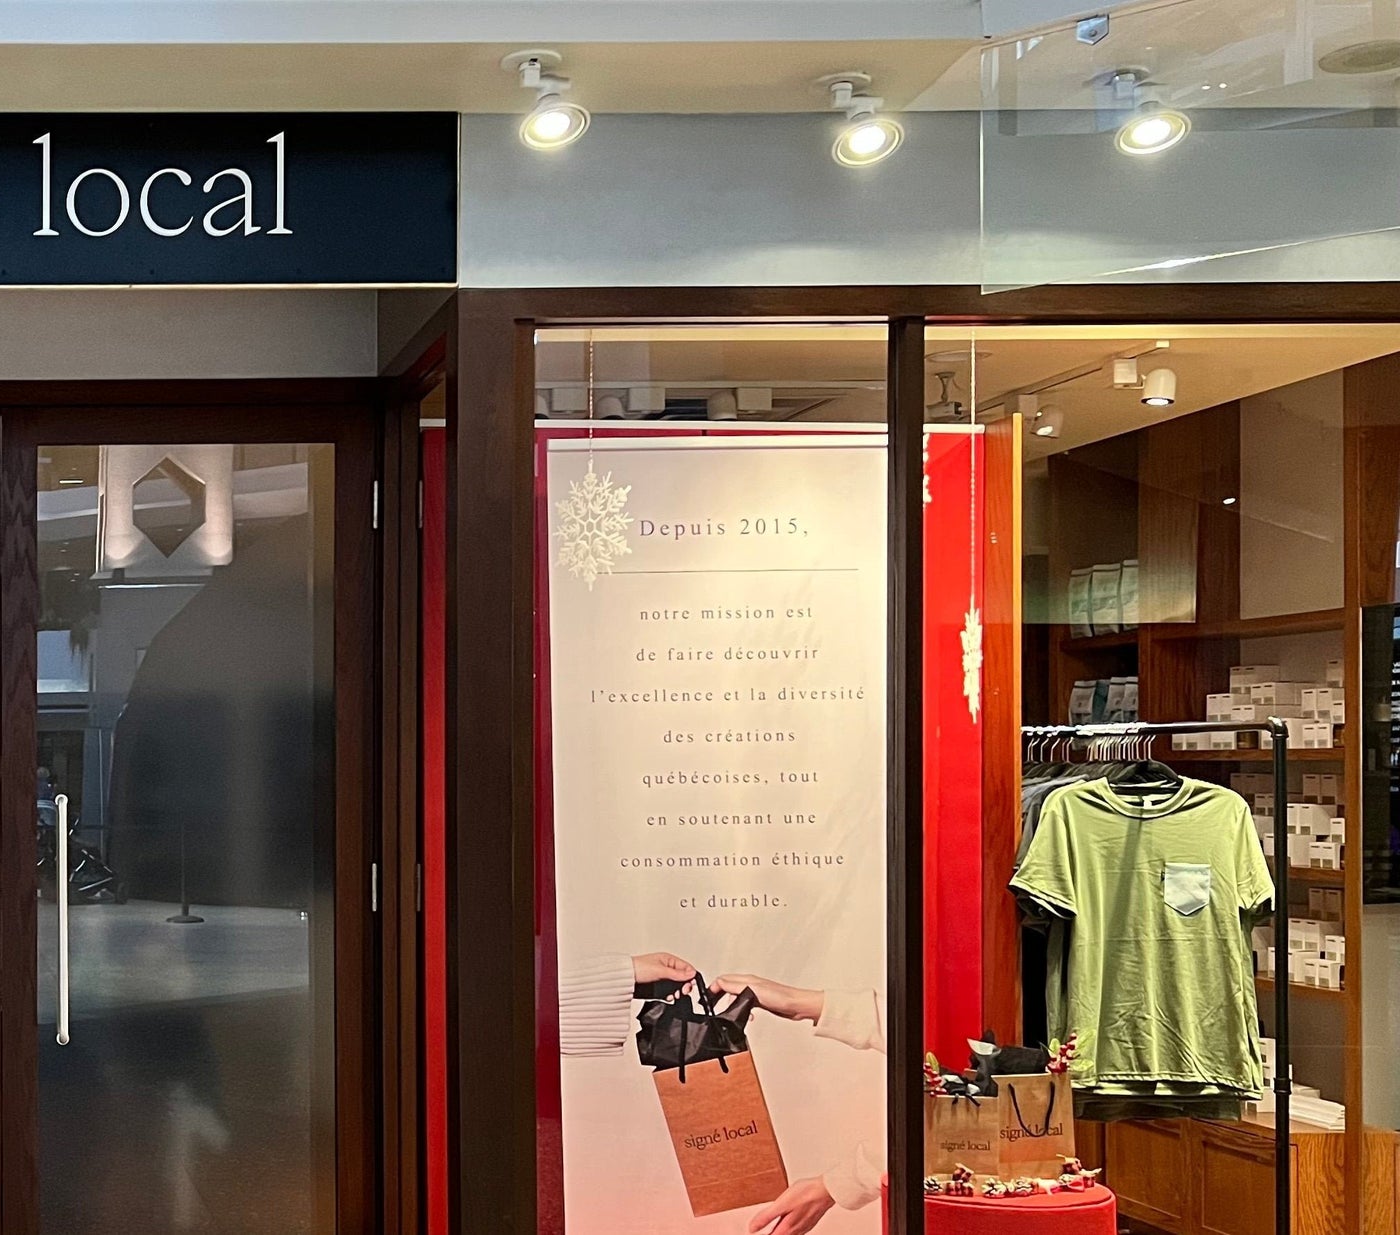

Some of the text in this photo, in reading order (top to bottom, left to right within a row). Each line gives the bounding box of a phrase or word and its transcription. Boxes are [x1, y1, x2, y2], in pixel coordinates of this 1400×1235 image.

[32, 131, 294, 237] local
[639, 518, 809, 540] Depuis 2015,
[639, 606, 812, 621] notre mission est
[636, 645, 819, 662] de faire découvrir
[591, 687, 864, 704] l'excellence et la diversité
[663, 729, 796, 744] des créations
[642, 770, 819, 789] québécoises, tout
[646, 813, 817, 827] en soutenant une
[620, 851, 845, 868] consommation éthique
[679, 894, 788, 909] et durable.
[684, 1120, 758, 1150] signé local
[967, 1140, 991, 1151] local
